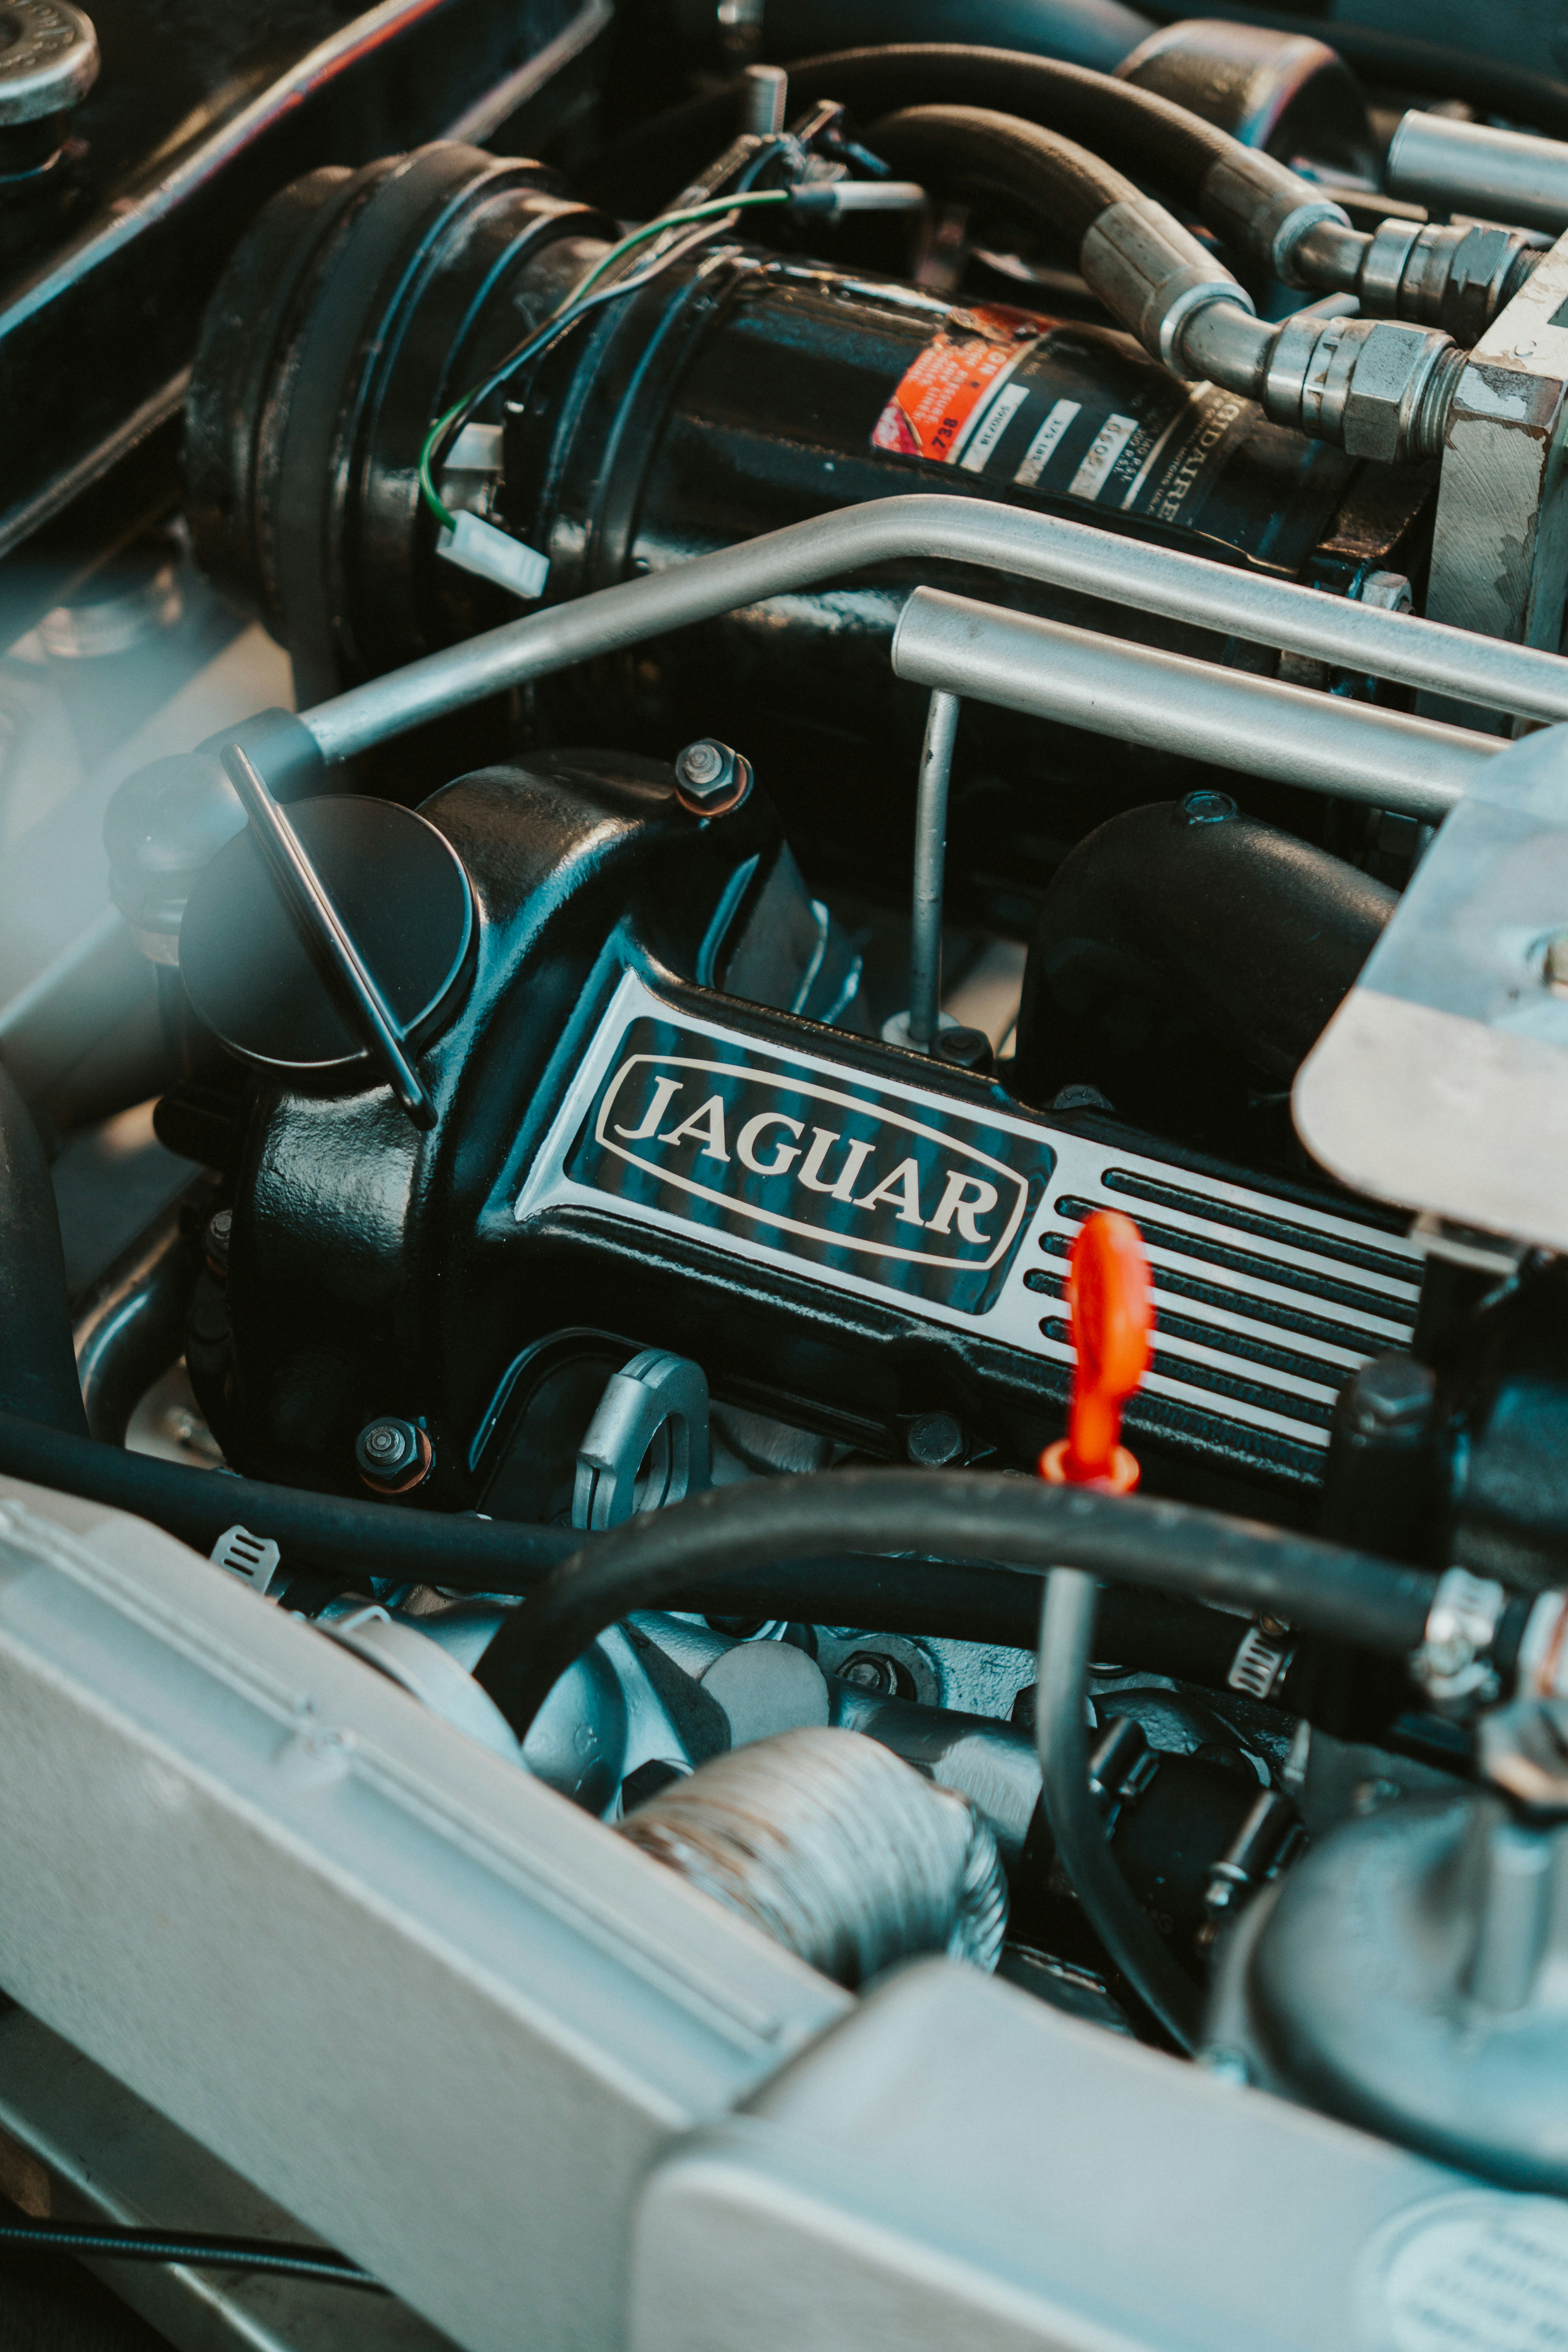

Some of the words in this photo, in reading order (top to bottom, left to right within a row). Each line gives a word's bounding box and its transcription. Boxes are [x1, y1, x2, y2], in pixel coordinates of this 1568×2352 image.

[931, 418, 958, 449] 738
[1160, 446, 1188, 484] MOTORS
[613, 1075, 999, 1244] JAGUAR
